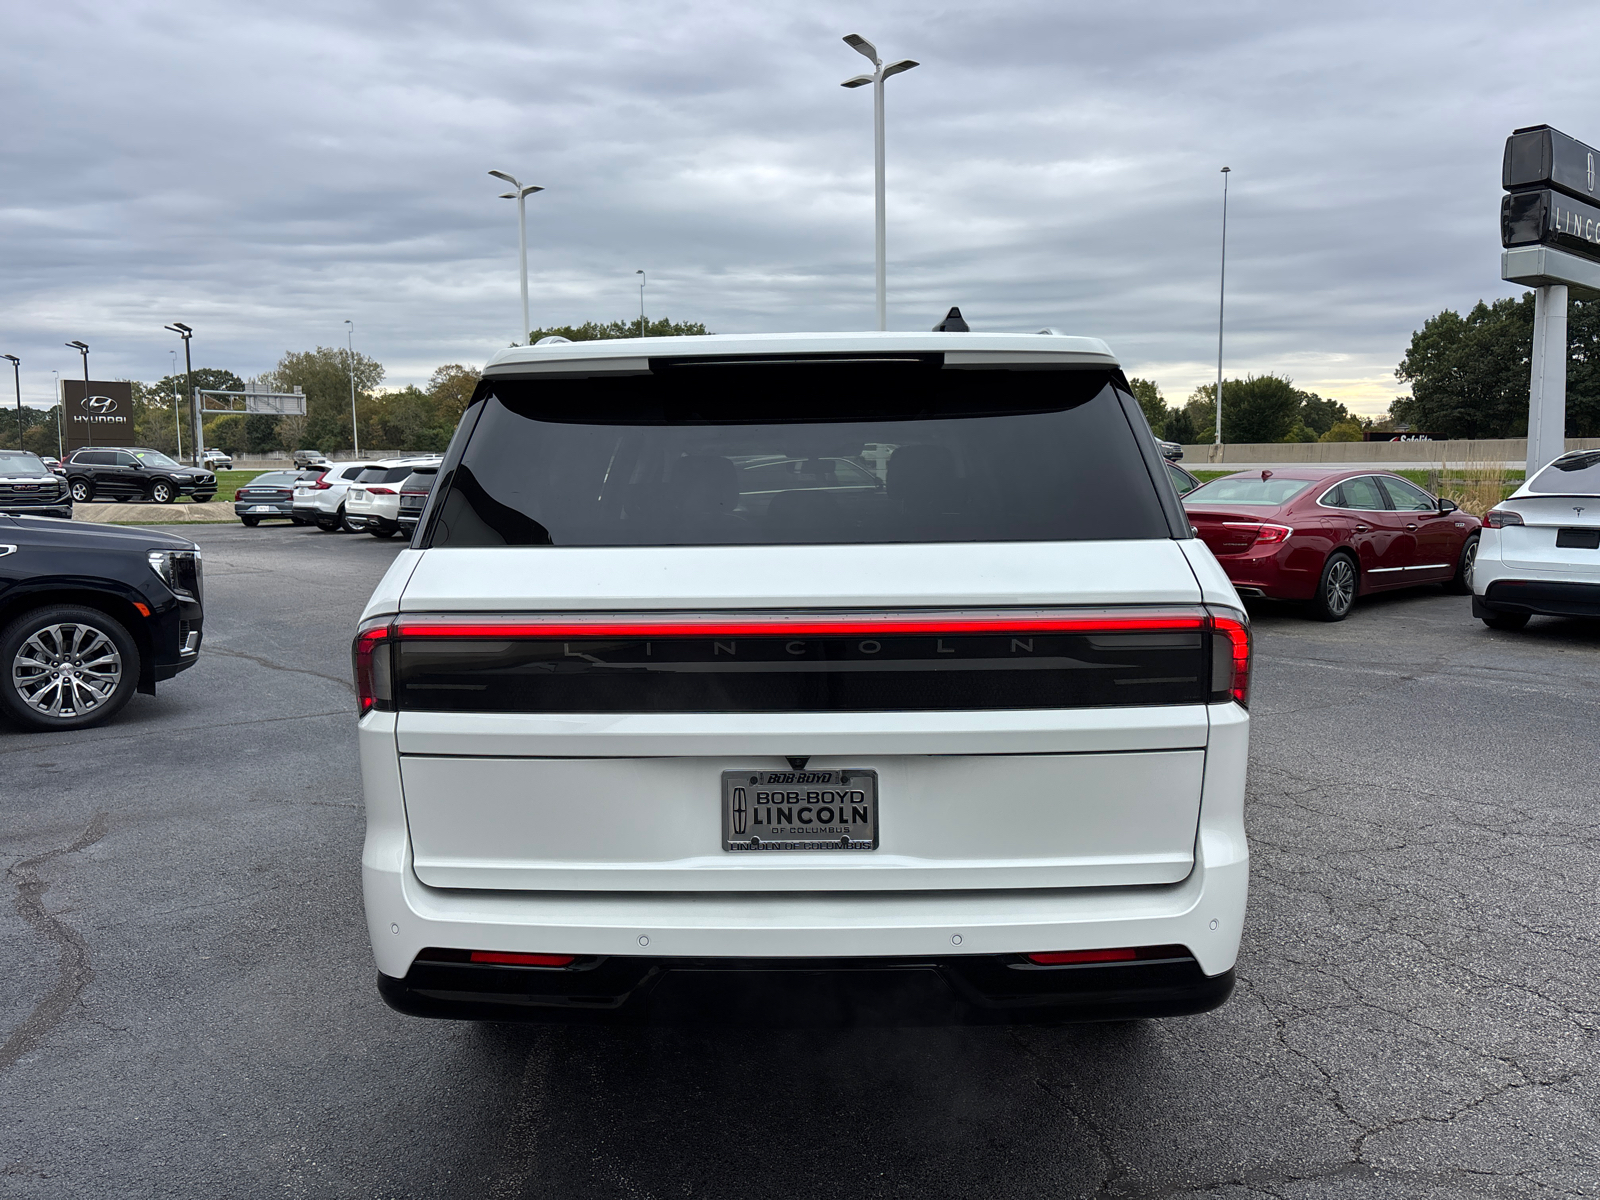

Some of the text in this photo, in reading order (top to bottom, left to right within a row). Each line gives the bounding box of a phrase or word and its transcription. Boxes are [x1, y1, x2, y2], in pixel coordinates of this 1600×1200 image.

[74, 415, 127, 425] HYUNDAI
[564, 638, 1033, 657] LINCOLN
[756, 790, 865, 805] BOB-BOYD
[753, 805, 868, 825] LINCOLN
[789, 826, 850, 834] COLUMBUS
[730, 841, 872, 851] LINCOLN OF COLUMBUS
